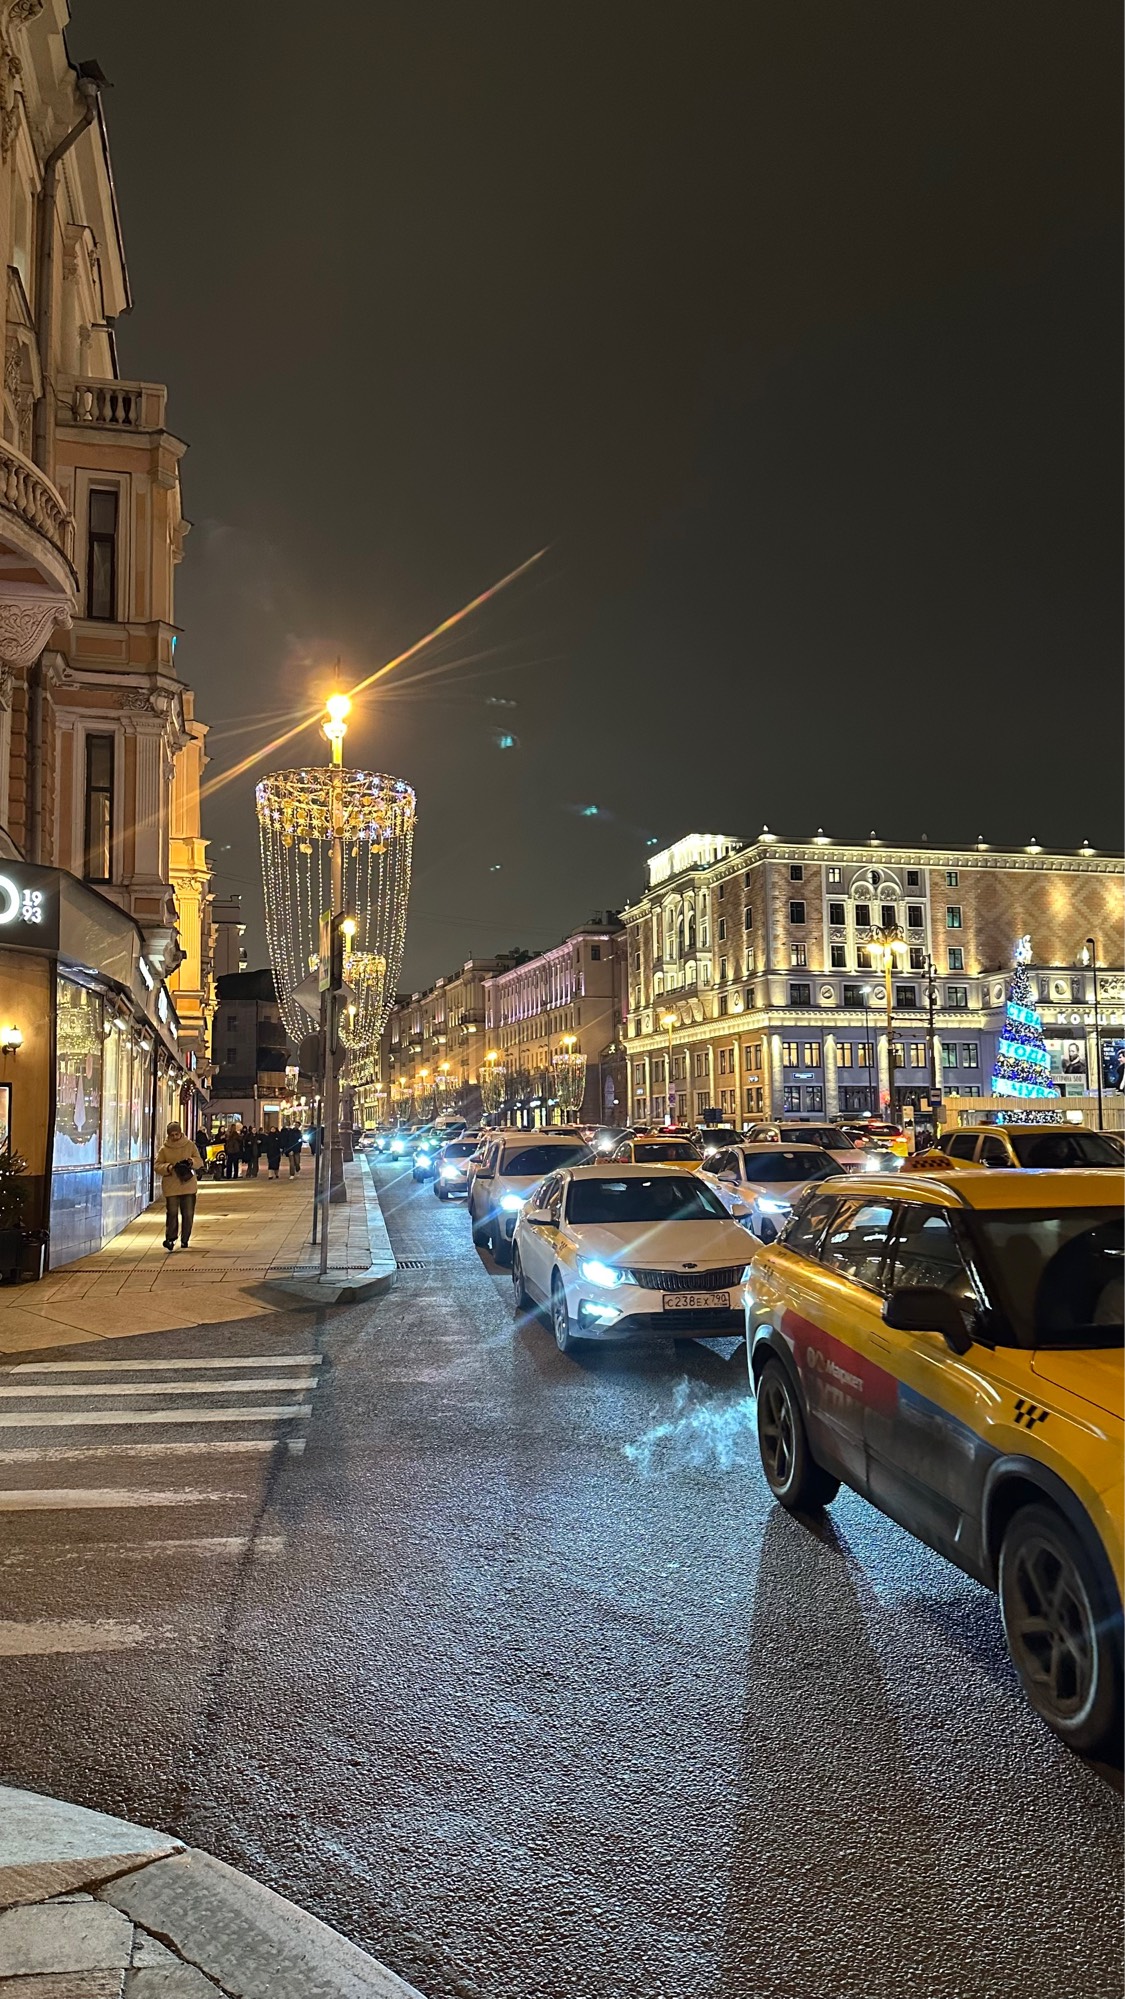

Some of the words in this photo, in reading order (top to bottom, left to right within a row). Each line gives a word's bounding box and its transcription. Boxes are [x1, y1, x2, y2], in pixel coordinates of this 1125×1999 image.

[22, 889, 42, 907] 19
[22, 905, 42, 924] 93
[1057, 1012, 1123, 1026] КОНЦЕ
